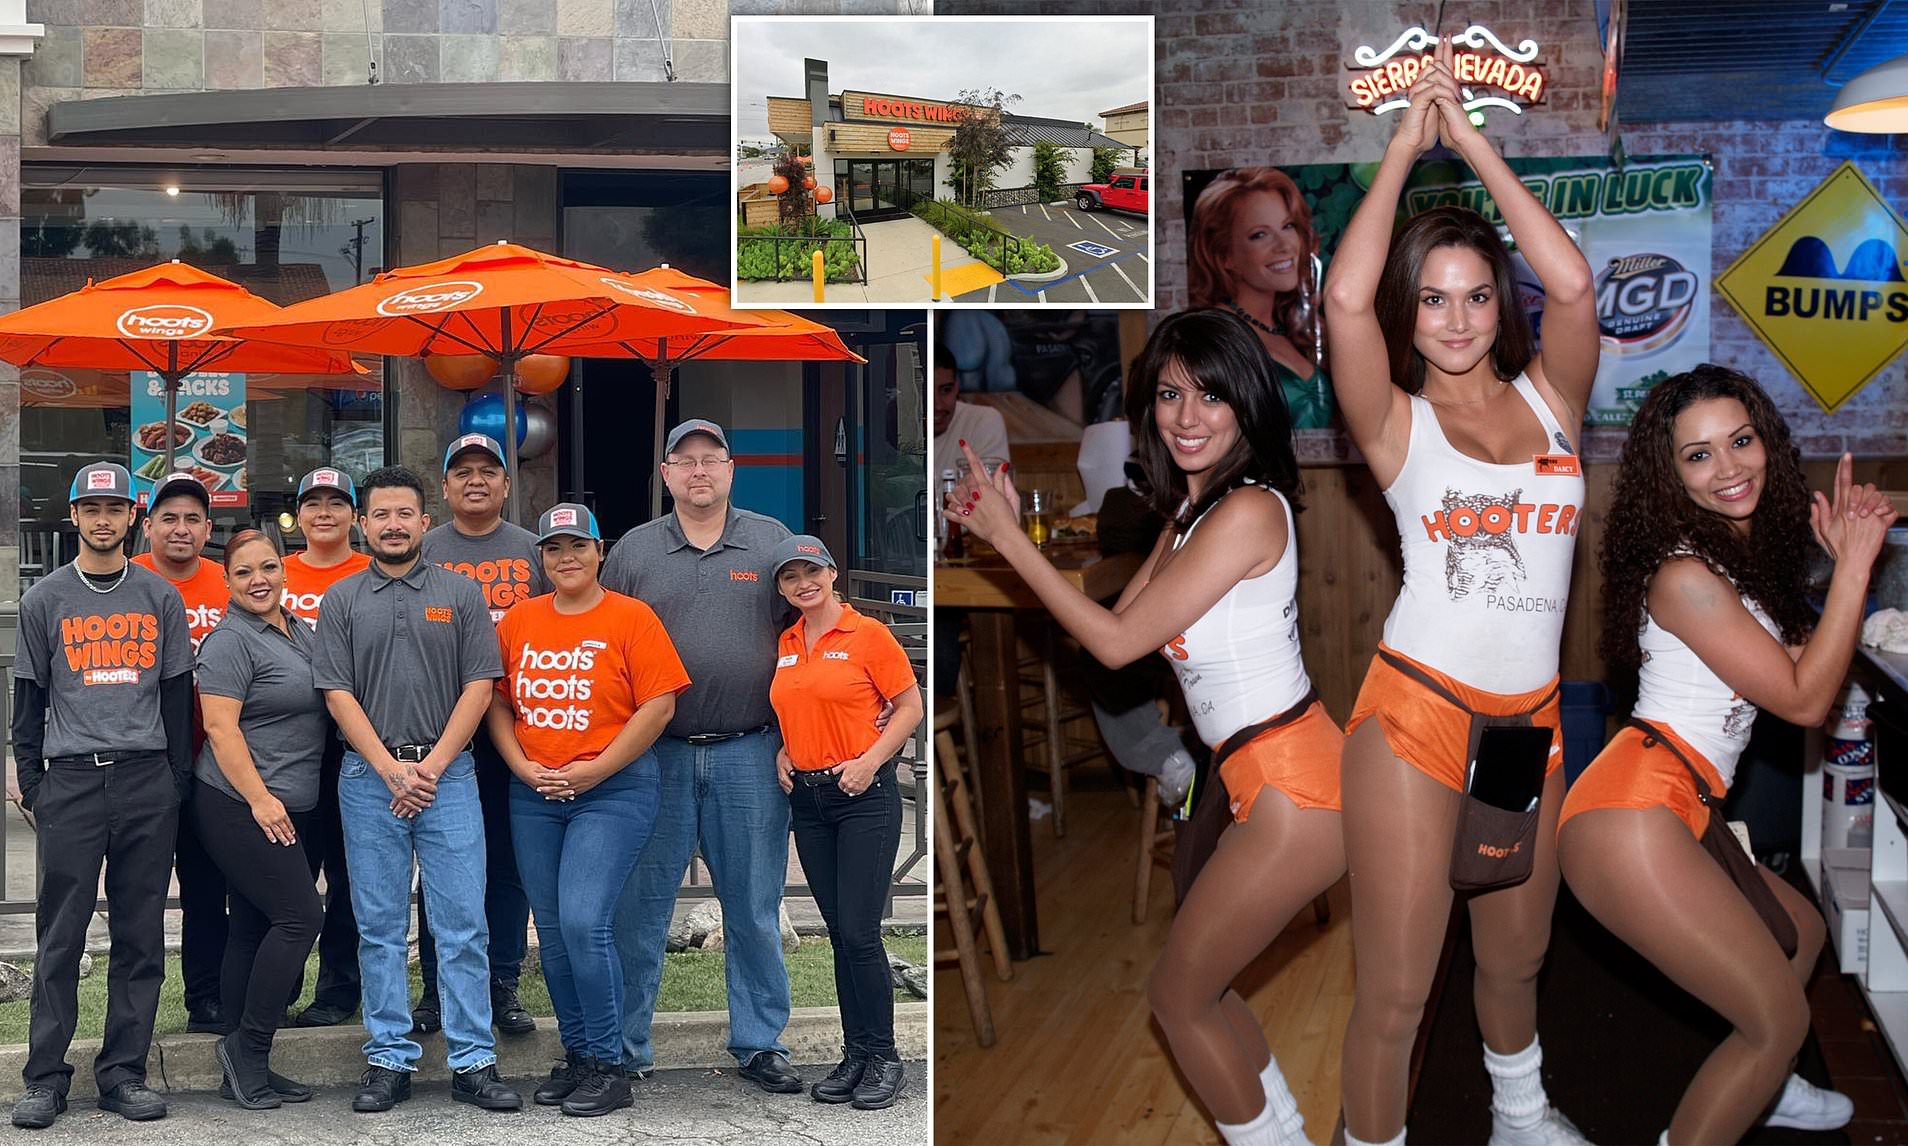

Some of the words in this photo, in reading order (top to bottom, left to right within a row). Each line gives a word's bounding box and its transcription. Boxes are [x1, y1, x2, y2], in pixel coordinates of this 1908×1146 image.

[863, 96, 920, 119] HOOTS
[923, 104, 971, 123] WING
[1552, 176, 1597, 214] IN
[1604, 166, 1700, 209] LUCK
[1609, 256, 1667, 276] Miller
[391, 290, 473, 304] hoots
[1765, 286, 1908, 323] BUMPS
[127, 314, 205, 328] hoots
[1607, 313, 1661, 328] GENUINE
[1615, 322, 1653, 335] DRAFT
[139, 327, 184, 336] wings
[147, 380, 161, 395] &
[167, 380, 230, 396] ACKS
[1554, 465, 1573, 474] DARCY
[797, 544, 820, 555] hoots
[730, 569, 758, 581] hoots
[1486, 594, 1557, 612] PASADENA
[185, 604, 222, 629] ots
[61, 612, 159, 645] HOOTS
[64, 640, 157, 672] WINGS
[520, 642, 595, 671] hoots
[823, 650, 849, 661] hoots
[516, 670, 592, 700] hoots
[517, 699, 590, 731] hoots
[1478, 841, 1521, 859] HOOTS
